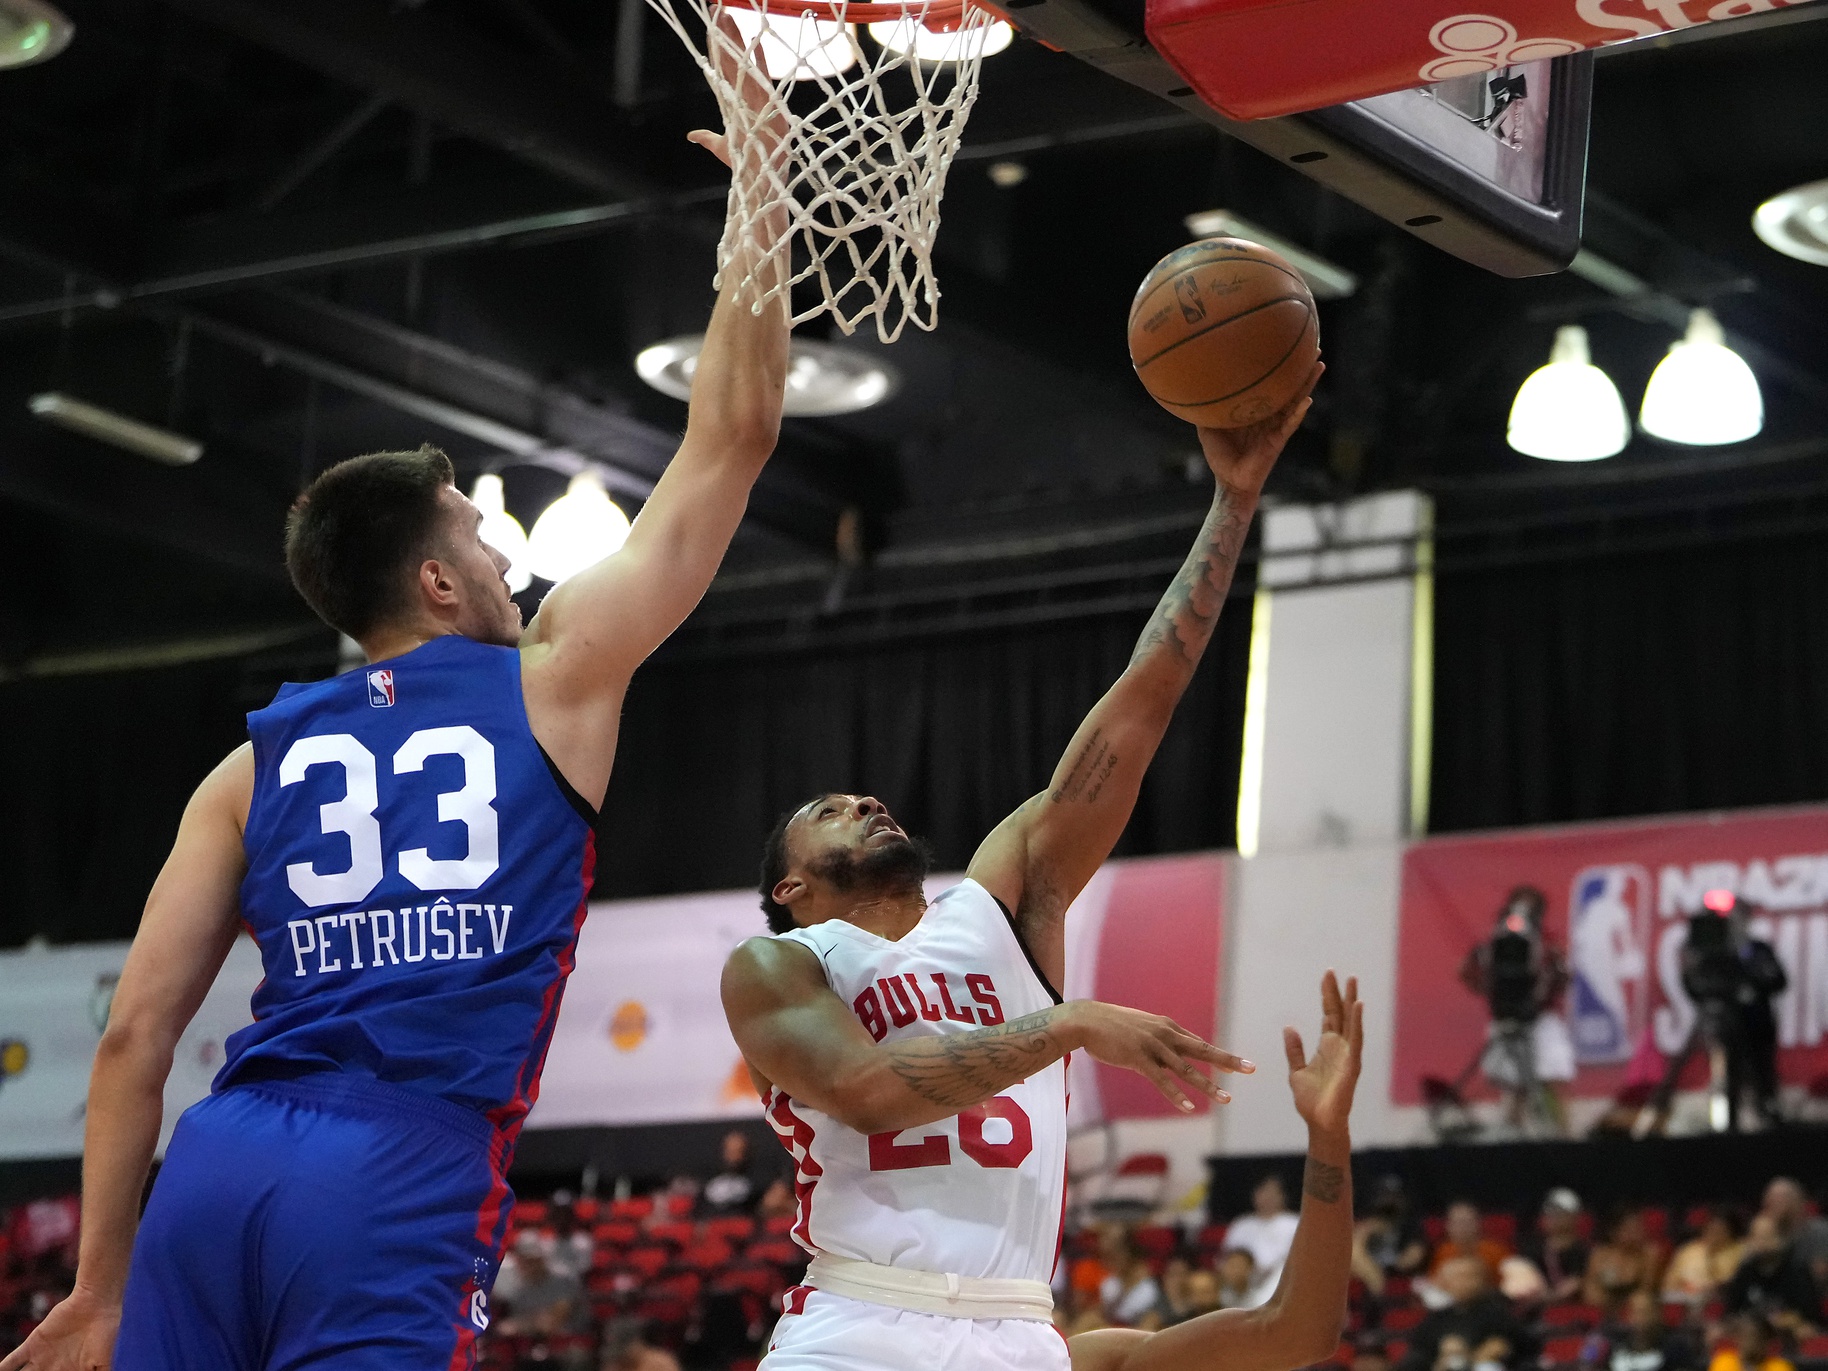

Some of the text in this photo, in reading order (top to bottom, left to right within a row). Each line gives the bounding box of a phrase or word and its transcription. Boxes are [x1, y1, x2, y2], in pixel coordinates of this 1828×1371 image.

[1576, 0, 1803, 46] Sta
[279, 725, 499, 908] 33
[853, 973, 1005, 1044] BULLS
